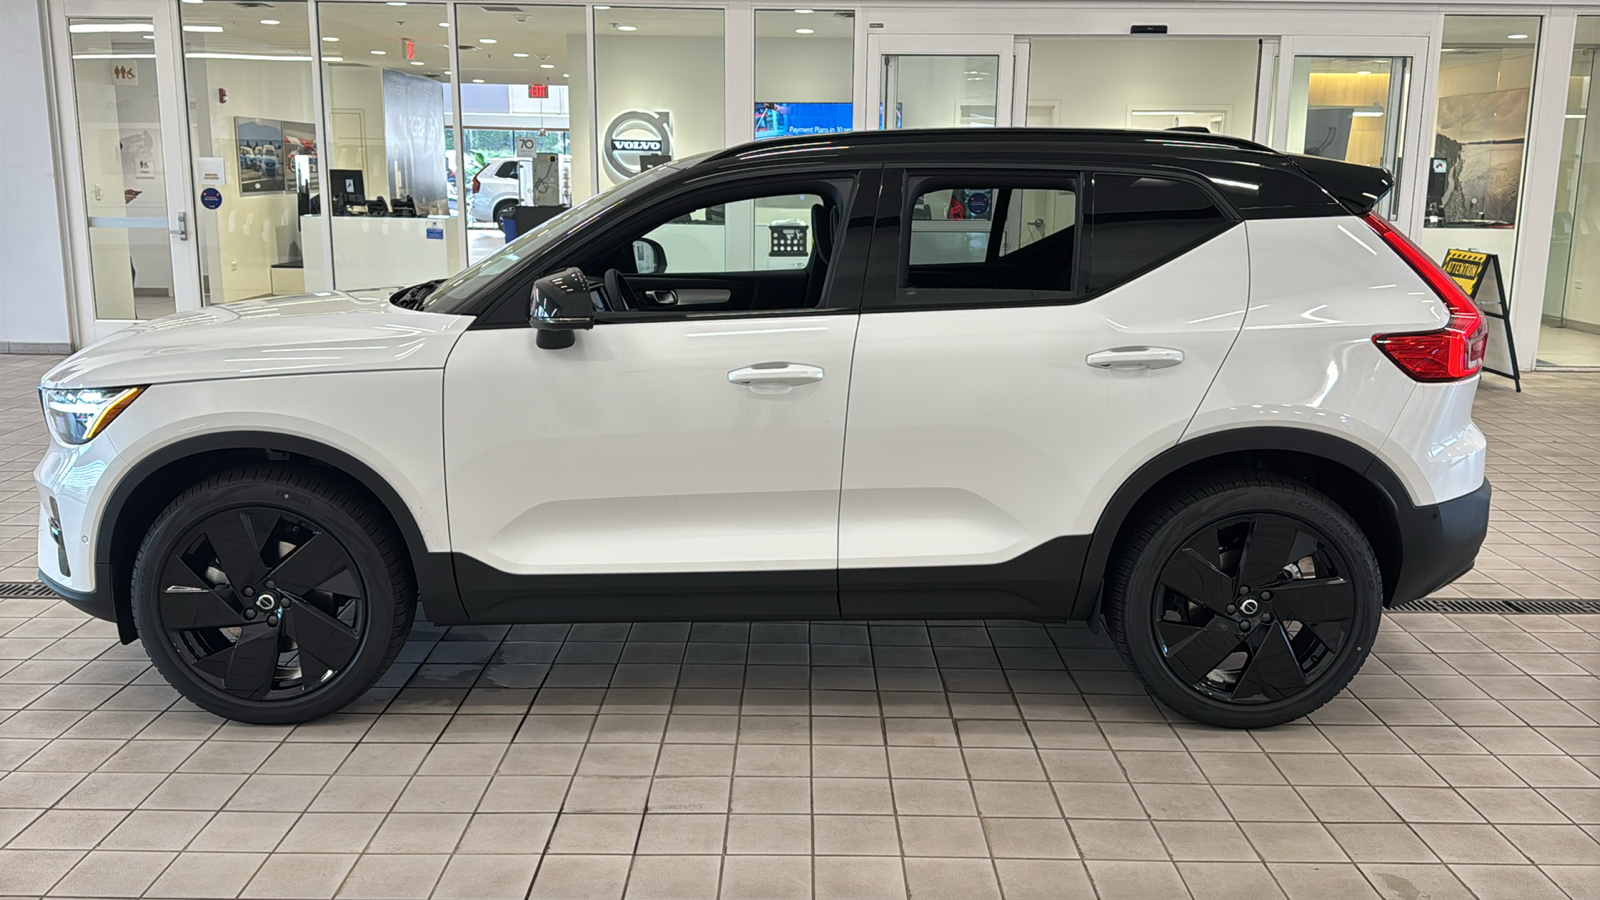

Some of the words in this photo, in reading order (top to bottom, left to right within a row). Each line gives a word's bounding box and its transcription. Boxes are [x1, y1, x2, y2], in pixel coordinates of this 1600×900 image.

[531, 85, 547, 98] EXIT
[789, 126, 813, 135] Payment
[519, 139, 534, 149] 70
[613, 141, 660, 149] VOLVO
[1446, 261, 1478, 277] ATTENTION
